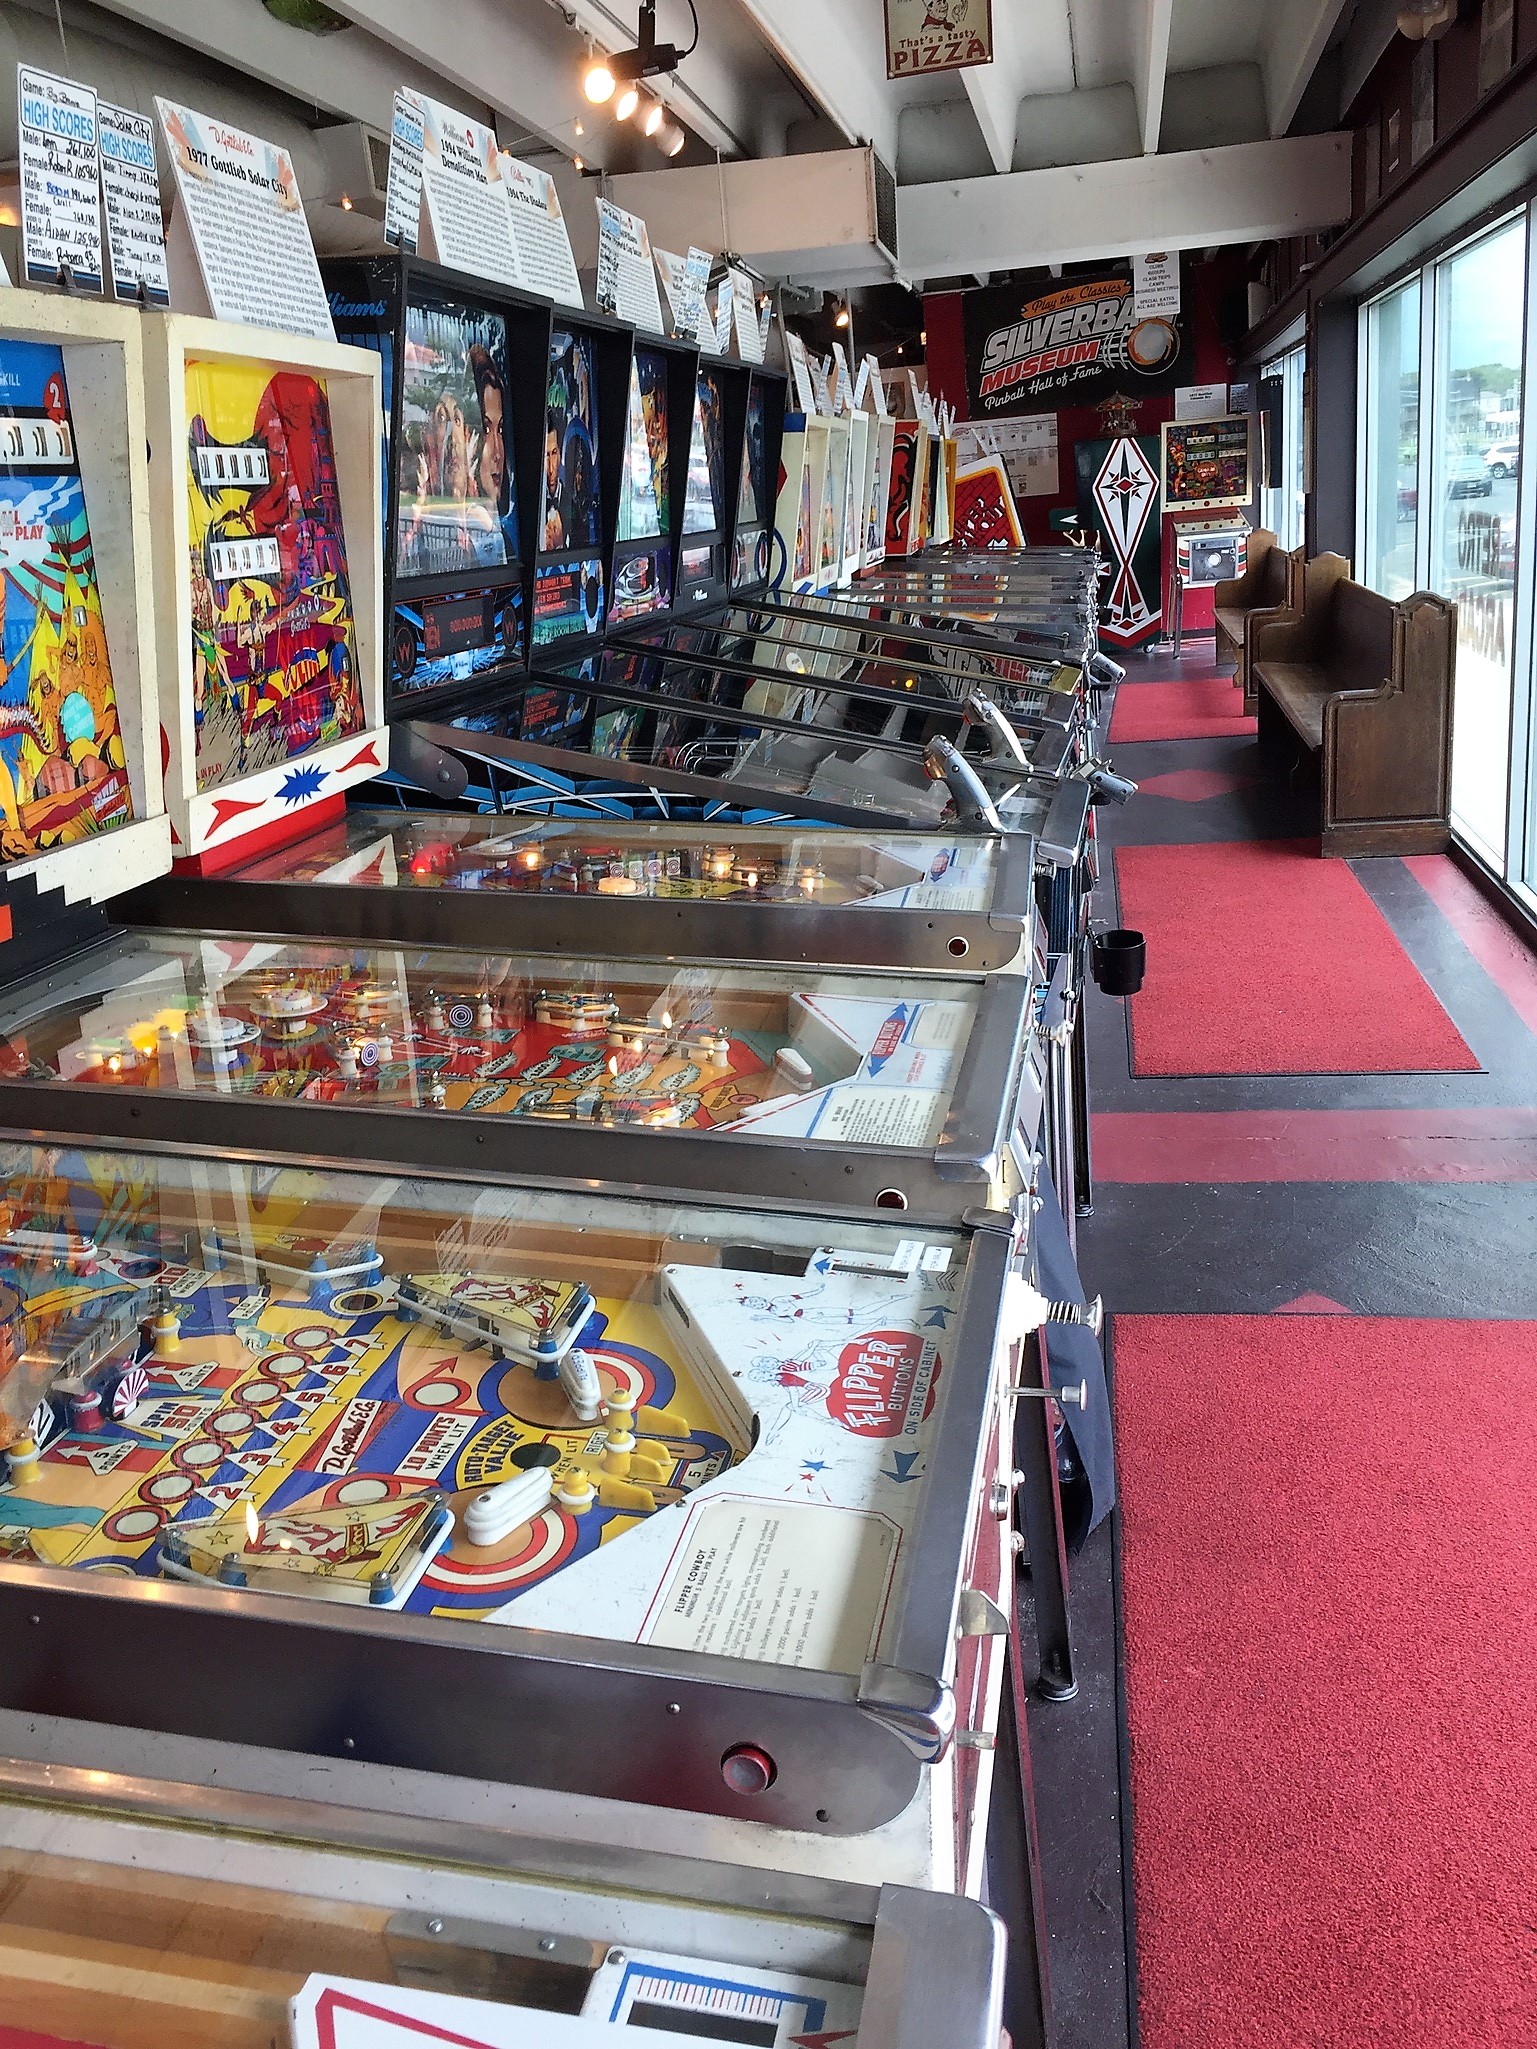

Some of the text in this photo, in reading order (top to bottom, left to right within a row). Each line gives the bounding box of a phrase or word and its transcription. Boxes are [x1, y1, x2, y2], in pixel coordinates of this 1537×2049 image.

[899, 36, 933, 48] That's
[948, 30, 976, 40] tasty
[894, 38, 986, 70] PIZZA
[22, 78, 45, 97] Game:
[23, 98, 94, 141] HIGH SCORES
[22, 130, 41, 146] Male:
[100, 130, 153, 168] HIGH SCORES
[441, 139, 482, 168] 1994 Williams
[186, 146, 288, 200] 1977 Gottlieb Solar City
[441, 154, 488, 185] Demolition Man
[24, 176, 42, 192] Male:
[25, 199, 52, 216] Female:
[26, 222, 44, 236] Male:
[27, 244, 54, 260] Female:
[1032, 285, 1121, 312] Play the Classics
[984, 296, 1158, 369] SILVERBA
[980, 340, 1100, 397] MUSEUM
[50, 382, 61, 408] 2
[984, 365, 1102, 410] Pinball Hall of Fame
[15, 525, 44, 540] PLAY
[344, 1339, 369, 1349] 7
[185, 1365, 213, 1387] POINTS
[321, 1365, 350, 1376] 6
[842, 1340, 908, 1427] FLIPPER
[888, 1358, 914, 1411] BUTTONS
[905, 1341, 937, 1435] ON SIDE OF CABINET
[296, 1392, 326, 1403] 5
[140, 1402, 179, 1427] SPIN
[160, 1404, 201, 1428] 50
[183, 1407, 213, 1431] POINTS
[274, 1422, 300, 1436] 4
[402, 1417, 456, 1471] 10 POINTS
[426, 1423, 468, 1470] WHEN LIT
[485, 1433, 525, 1474] VALUE
[566, 1439, 578, 1453] LIT
[586, 1432, 608, 1453] RIGHT
[99, 1444, 131, 1470] POINTS
[239, 1453, 272, 1466] 3
[688, 1471, 701, 1482] 5
[209, 1486, 243, 1500] 2
[698, 1572, 707, 1586] BALLS
[708, 1548, 717, 1560] PLAY
[674, 1549, 706, 1612] FLIPPER COWBOY
[707, 1597, 715, 1612] yellow
[716, 1591, 728, 1615] additional
[771, 1600, 781, 1614] target
[724, 1620, 736, 1645] numbered
[749, 1617, 757, 1629] adds
[784, 1619, 792, 1635] points
[788, 1606, 796, 1617] adds
[795, 1639, 805, 1653] 5000
[802, 1622, 810, 1638] points
